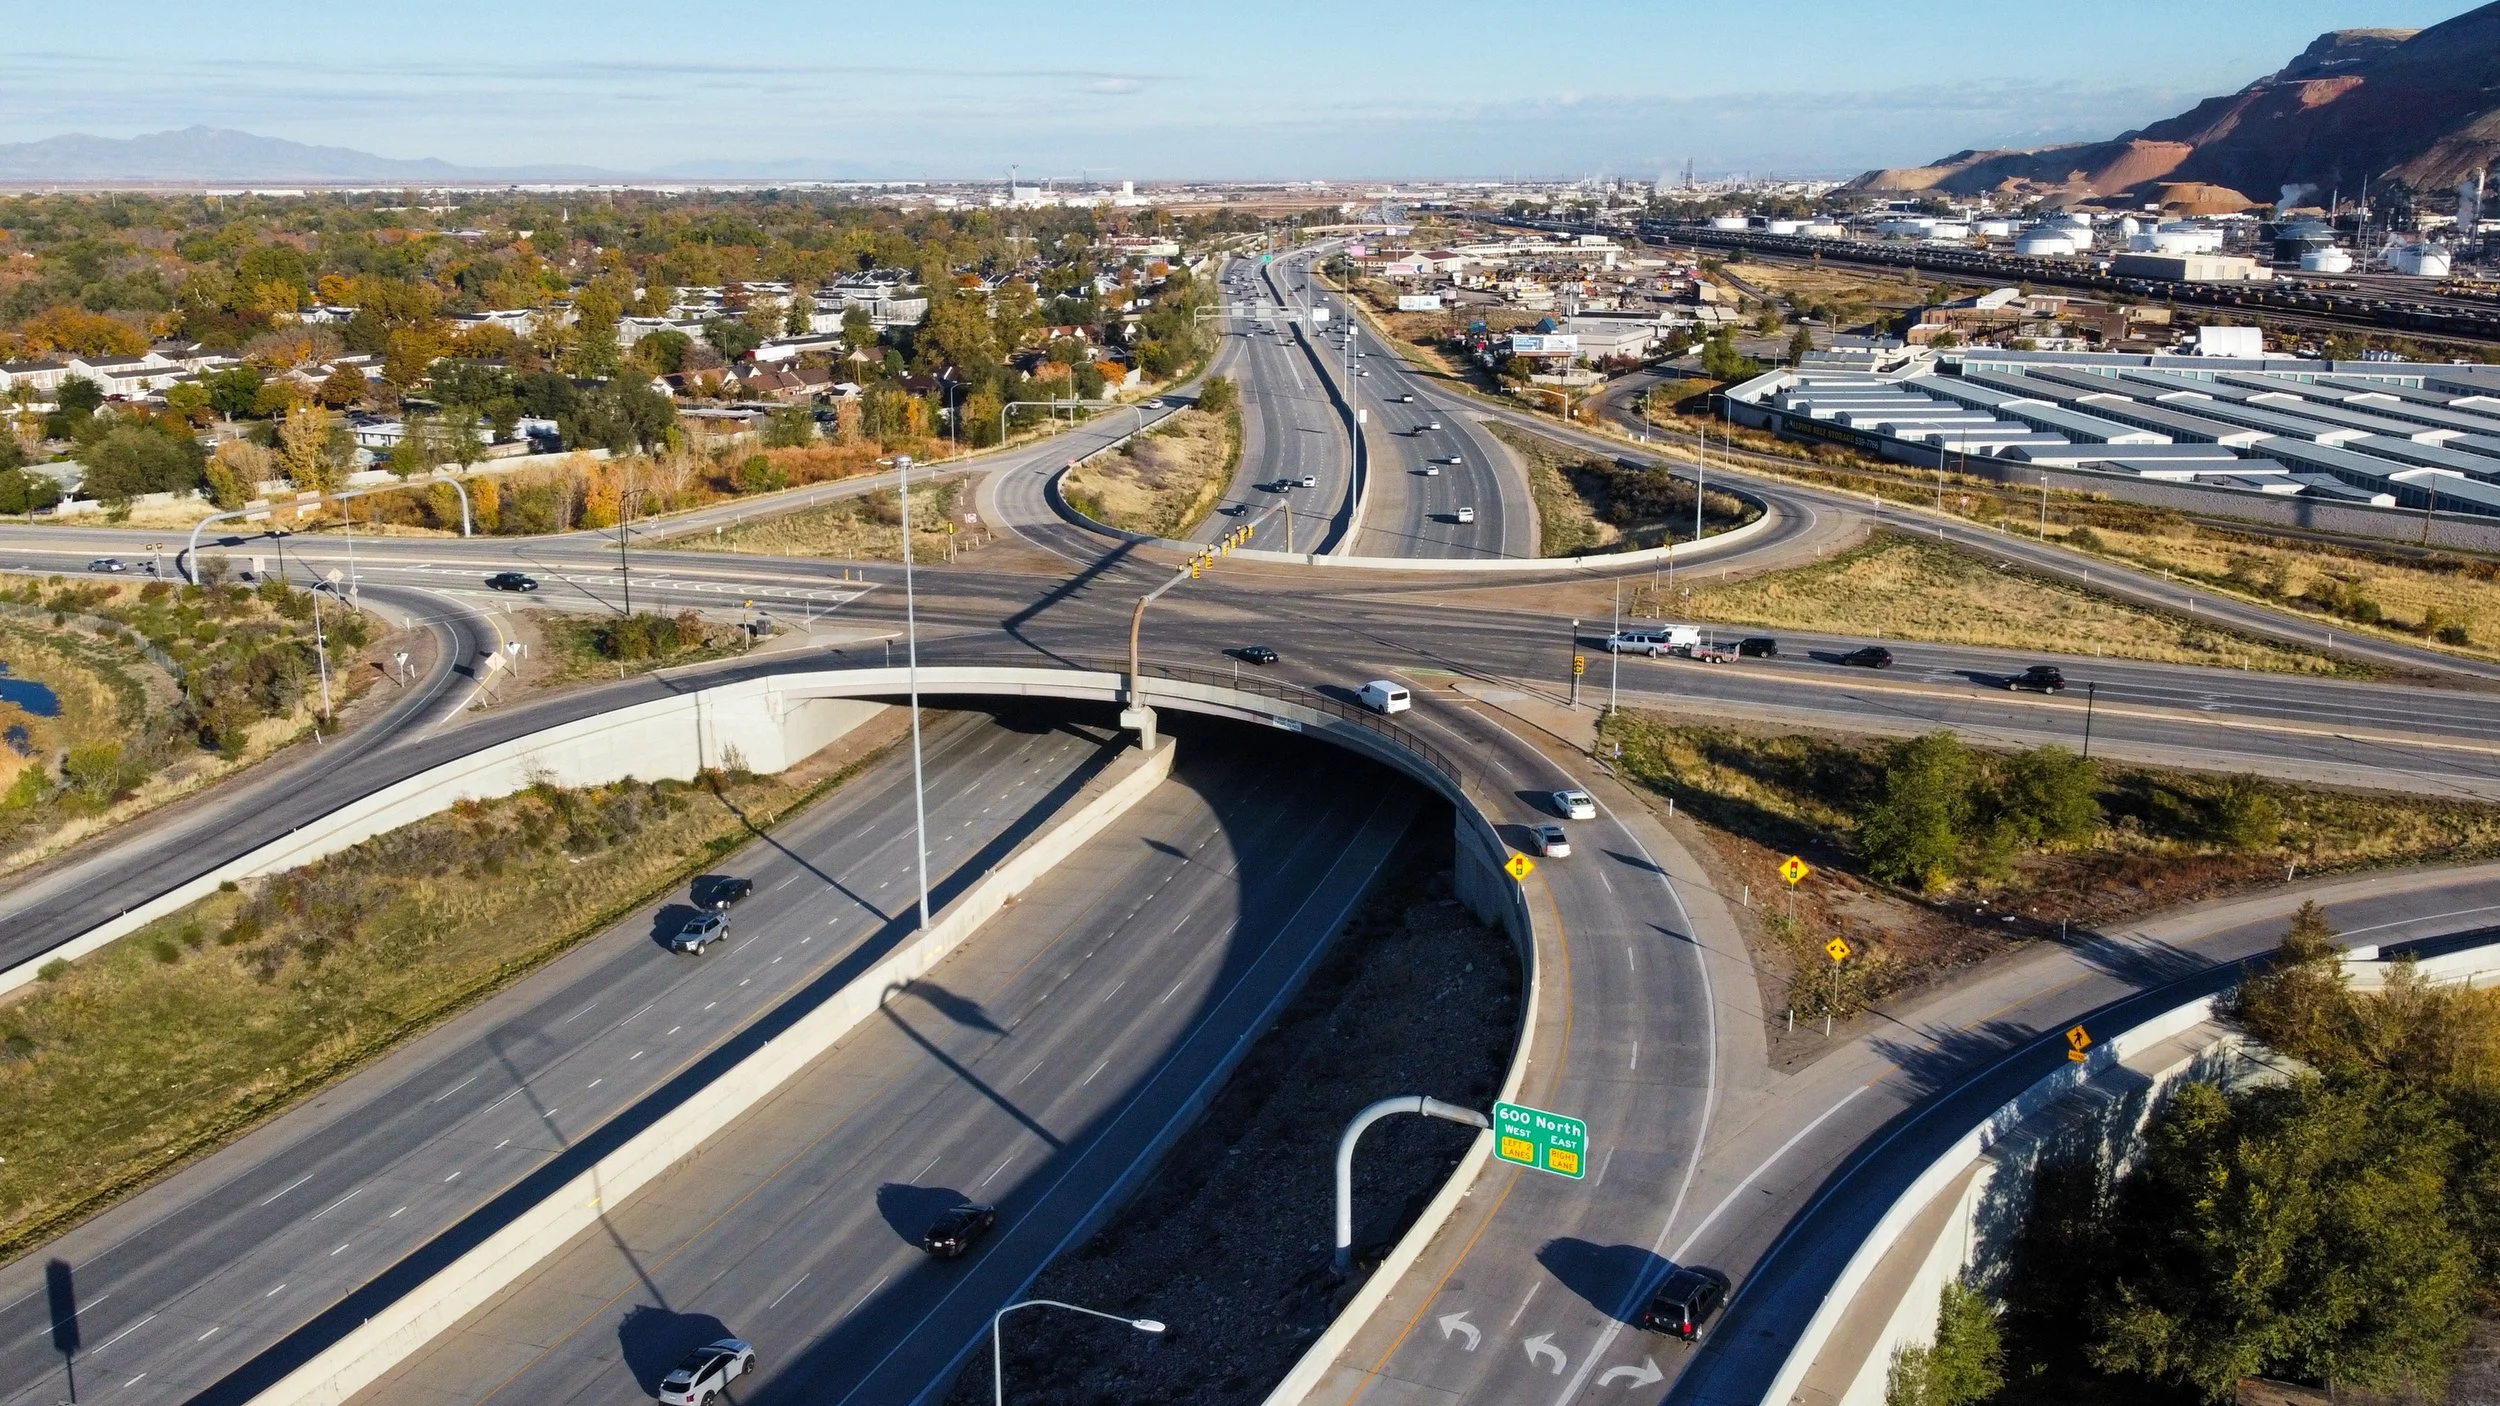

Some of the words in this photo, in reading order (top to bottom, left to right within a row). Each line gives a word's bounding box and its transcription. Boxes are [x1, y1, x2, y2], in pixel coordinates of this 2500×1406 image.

[1827, 430, 1854, 443] STORAGE
[1499, 1108, 1530, 1124] 600
[1536, 1116, 1581, 1137] North
[1505, 1124, 1531, 1138] WEST
[1503, 1138, 1522, 1149] LEFT
[1527, 1144, 1532, 1152] 2
[1551, 1135, 1577, 1149] EAST
[1504, 1147, 1530, 1160] LANES
[1551, 1151, 1575, 1162] RIGHT
[1552, 1161, 1574, 1171] LANE
